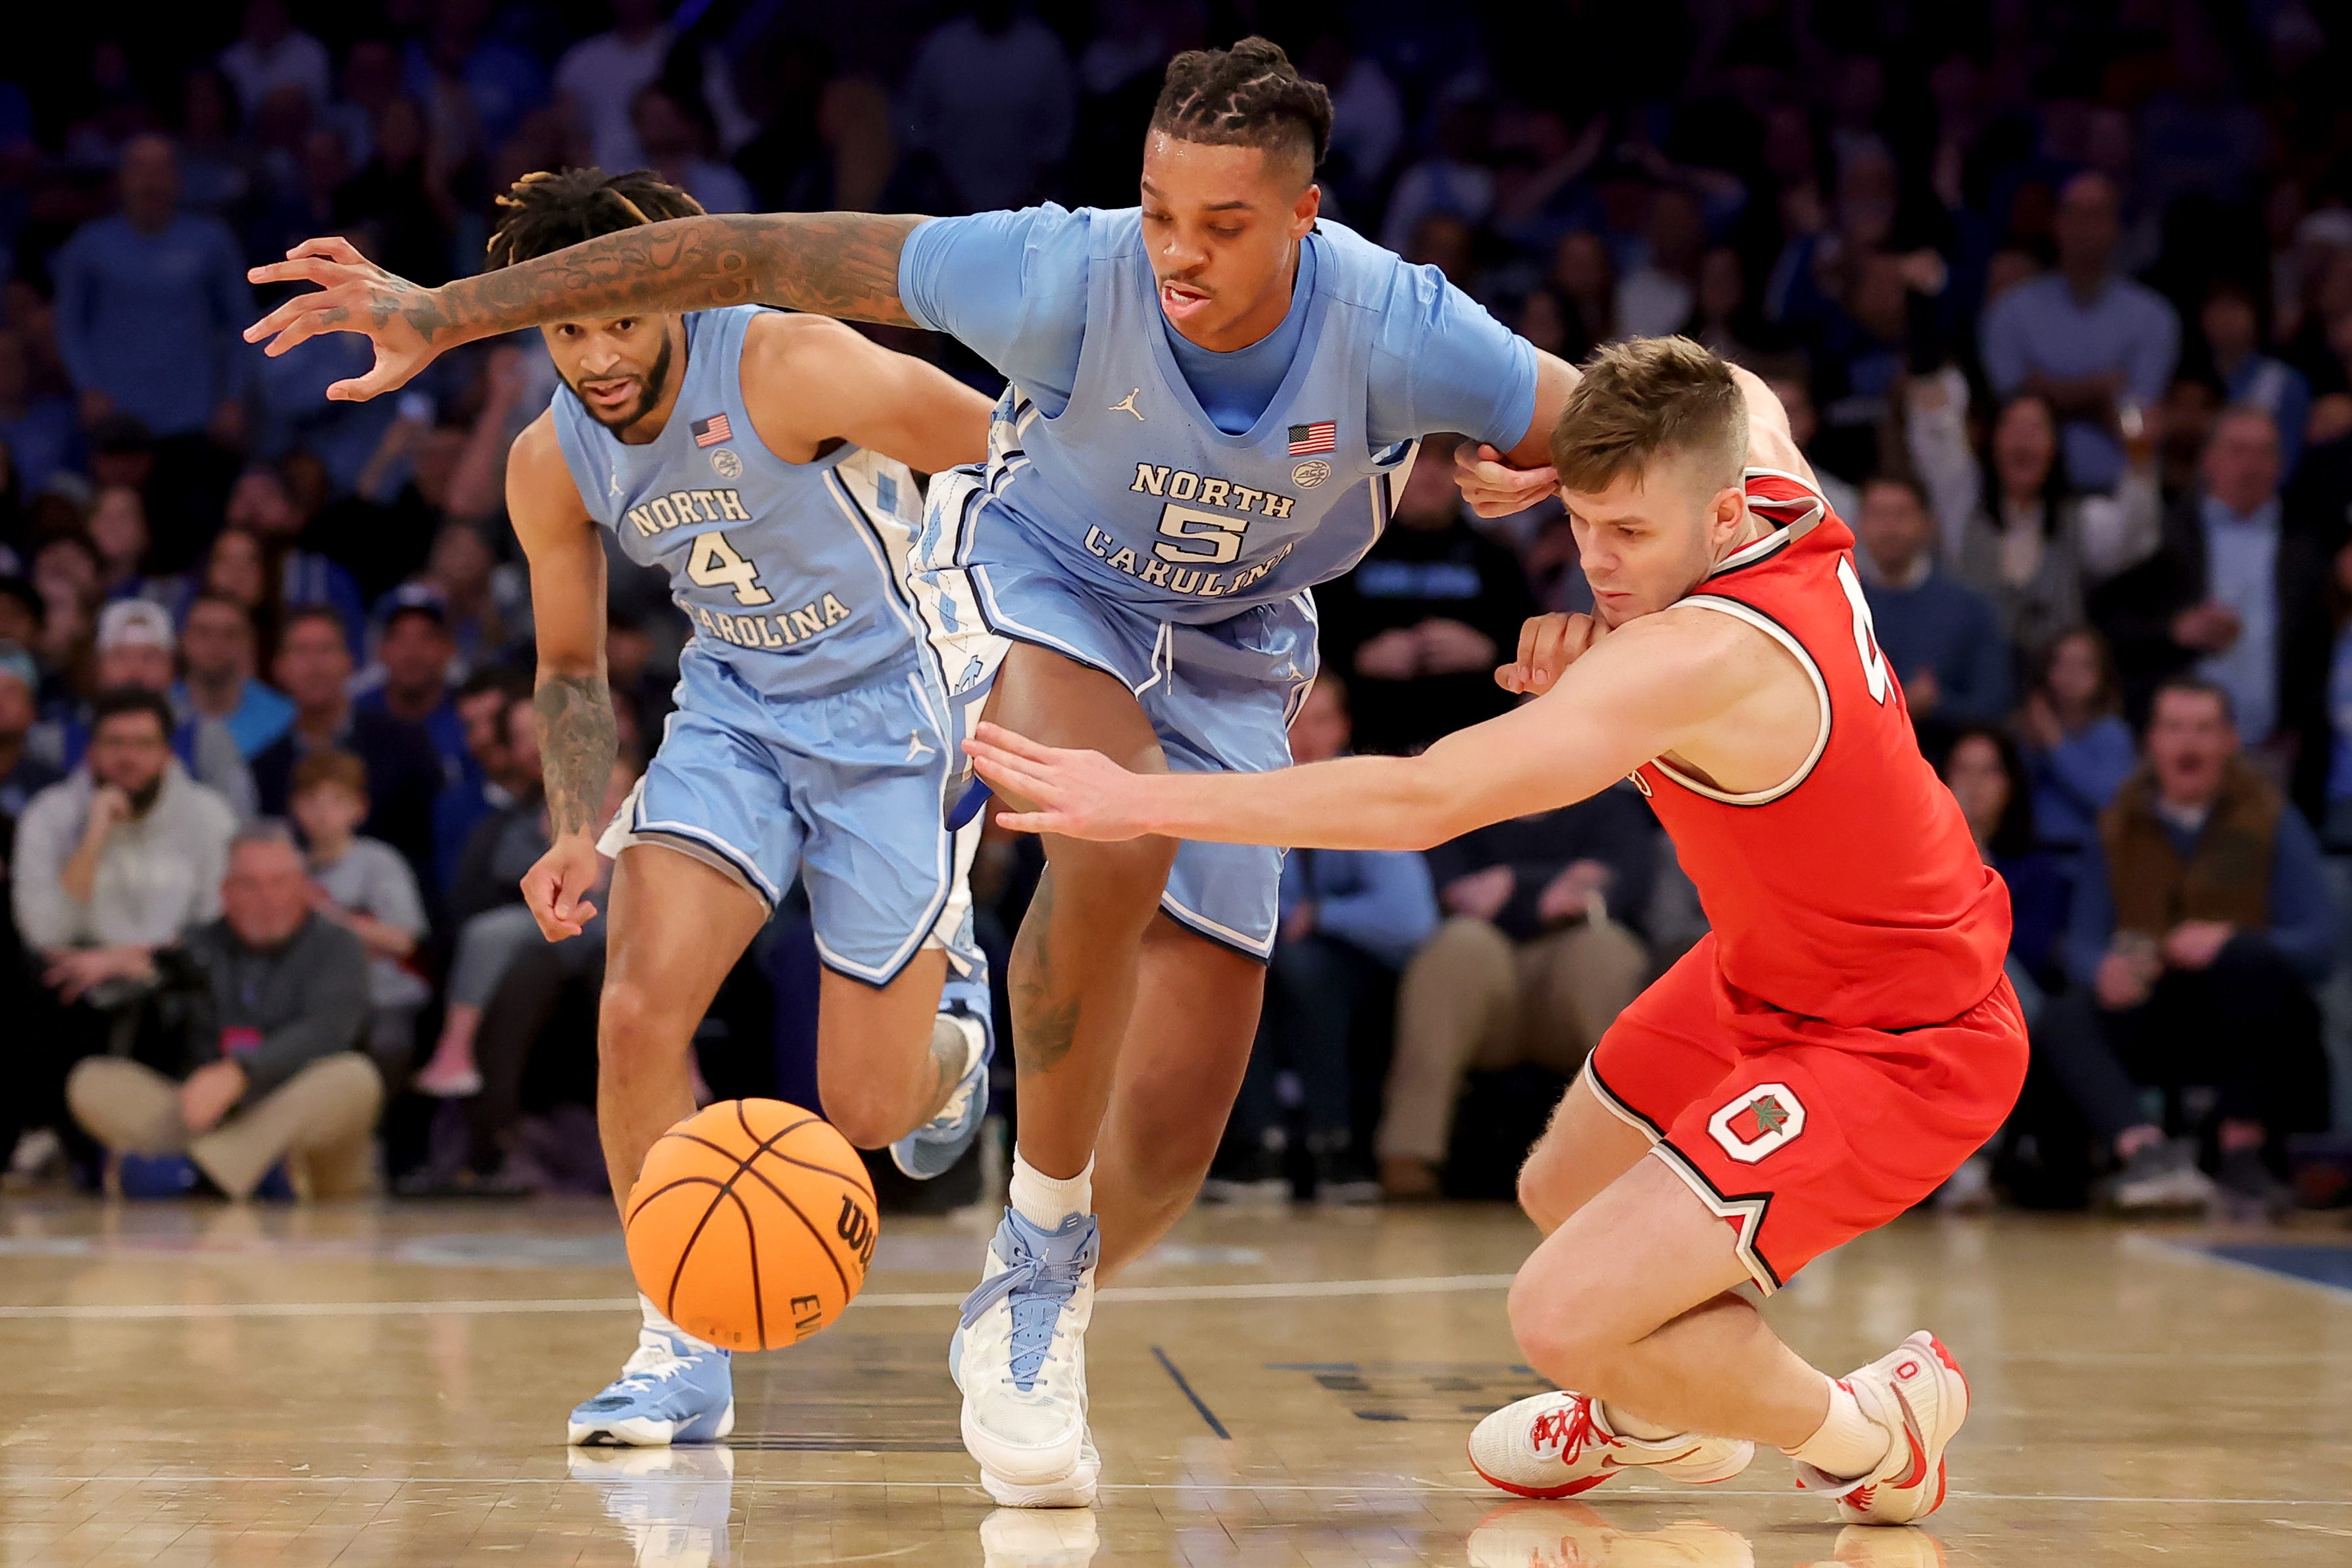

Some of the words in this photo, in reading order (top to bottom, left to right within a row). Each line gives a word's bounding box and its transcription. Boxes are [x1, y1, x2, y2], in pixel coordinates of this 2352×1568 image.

[627, 489, 753, 537] NORTH
[1130, 462, 1295, 518] NORTH
[1152, 502, 1249, 564] 5
[686, 531, 775, 606] 4
